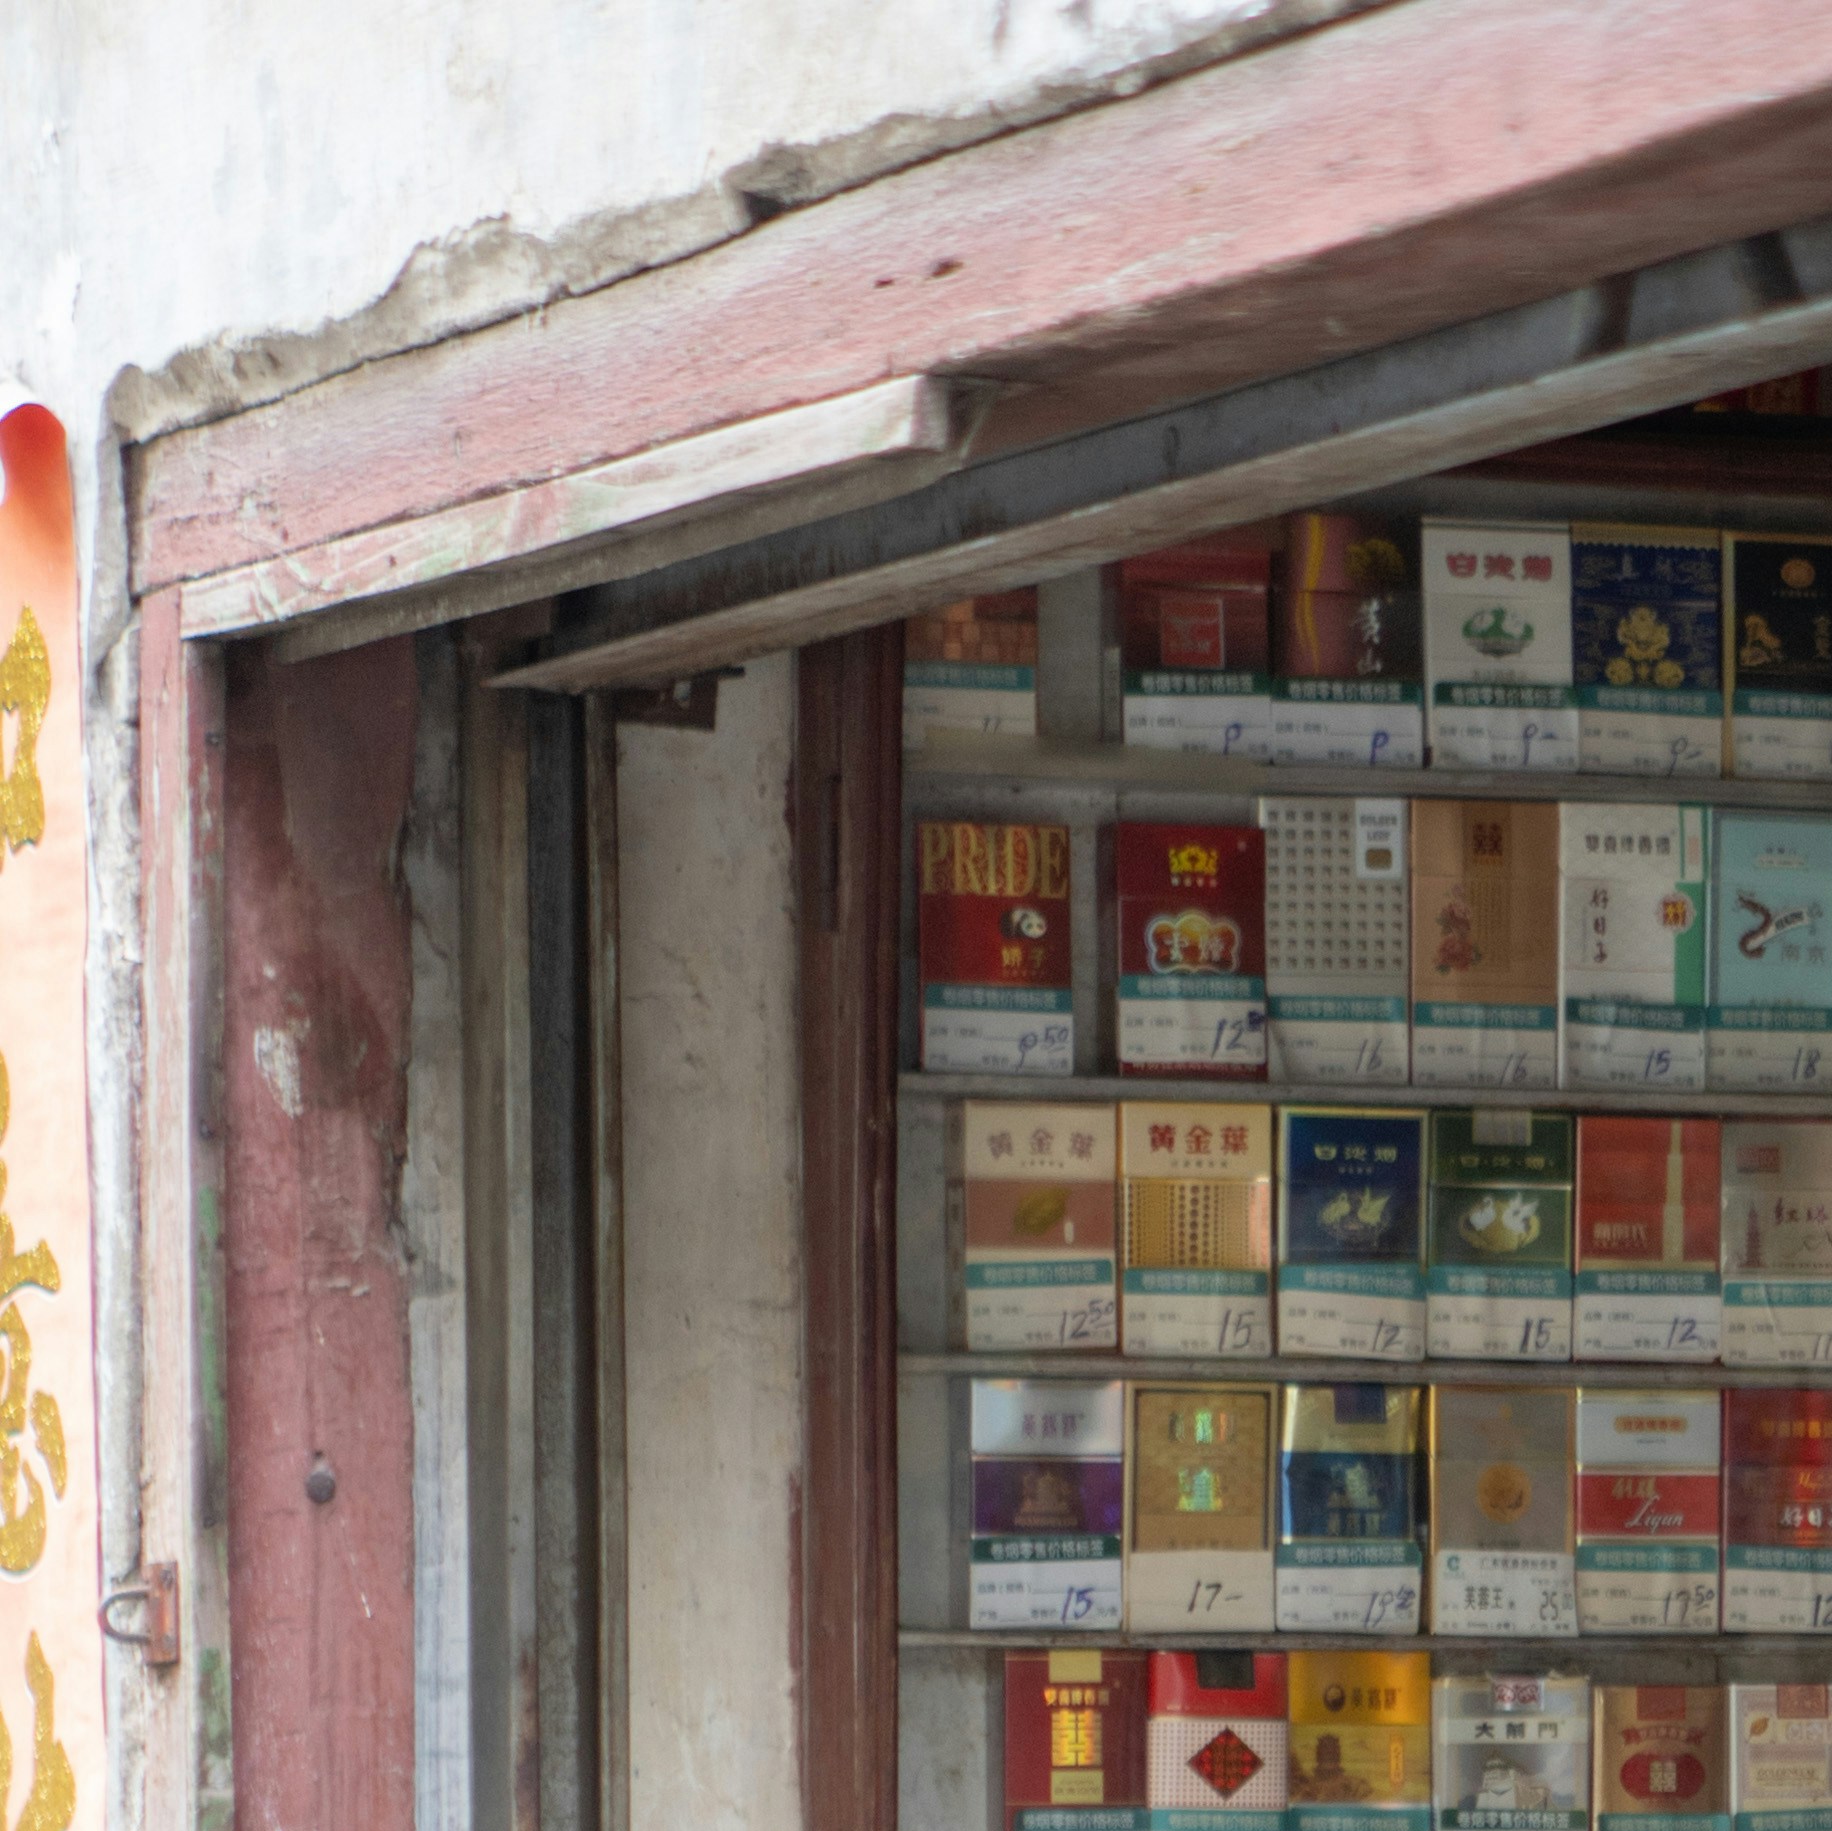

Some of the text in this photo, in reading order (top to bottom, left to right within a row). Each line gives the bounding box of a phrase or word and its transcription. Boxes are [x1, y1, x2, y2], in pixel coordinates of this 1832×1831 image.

[921, 824, 1068, 898] PRIDE
[1219, 1309, 1255, 1352] 15
[1372, 1319, 1401, 1352] 12
[1520, 1317, 1554, 1353] 15
[1666, 1316, 1700, 1350] 12
[1625, 1495, 1685, 1533] Liqun
